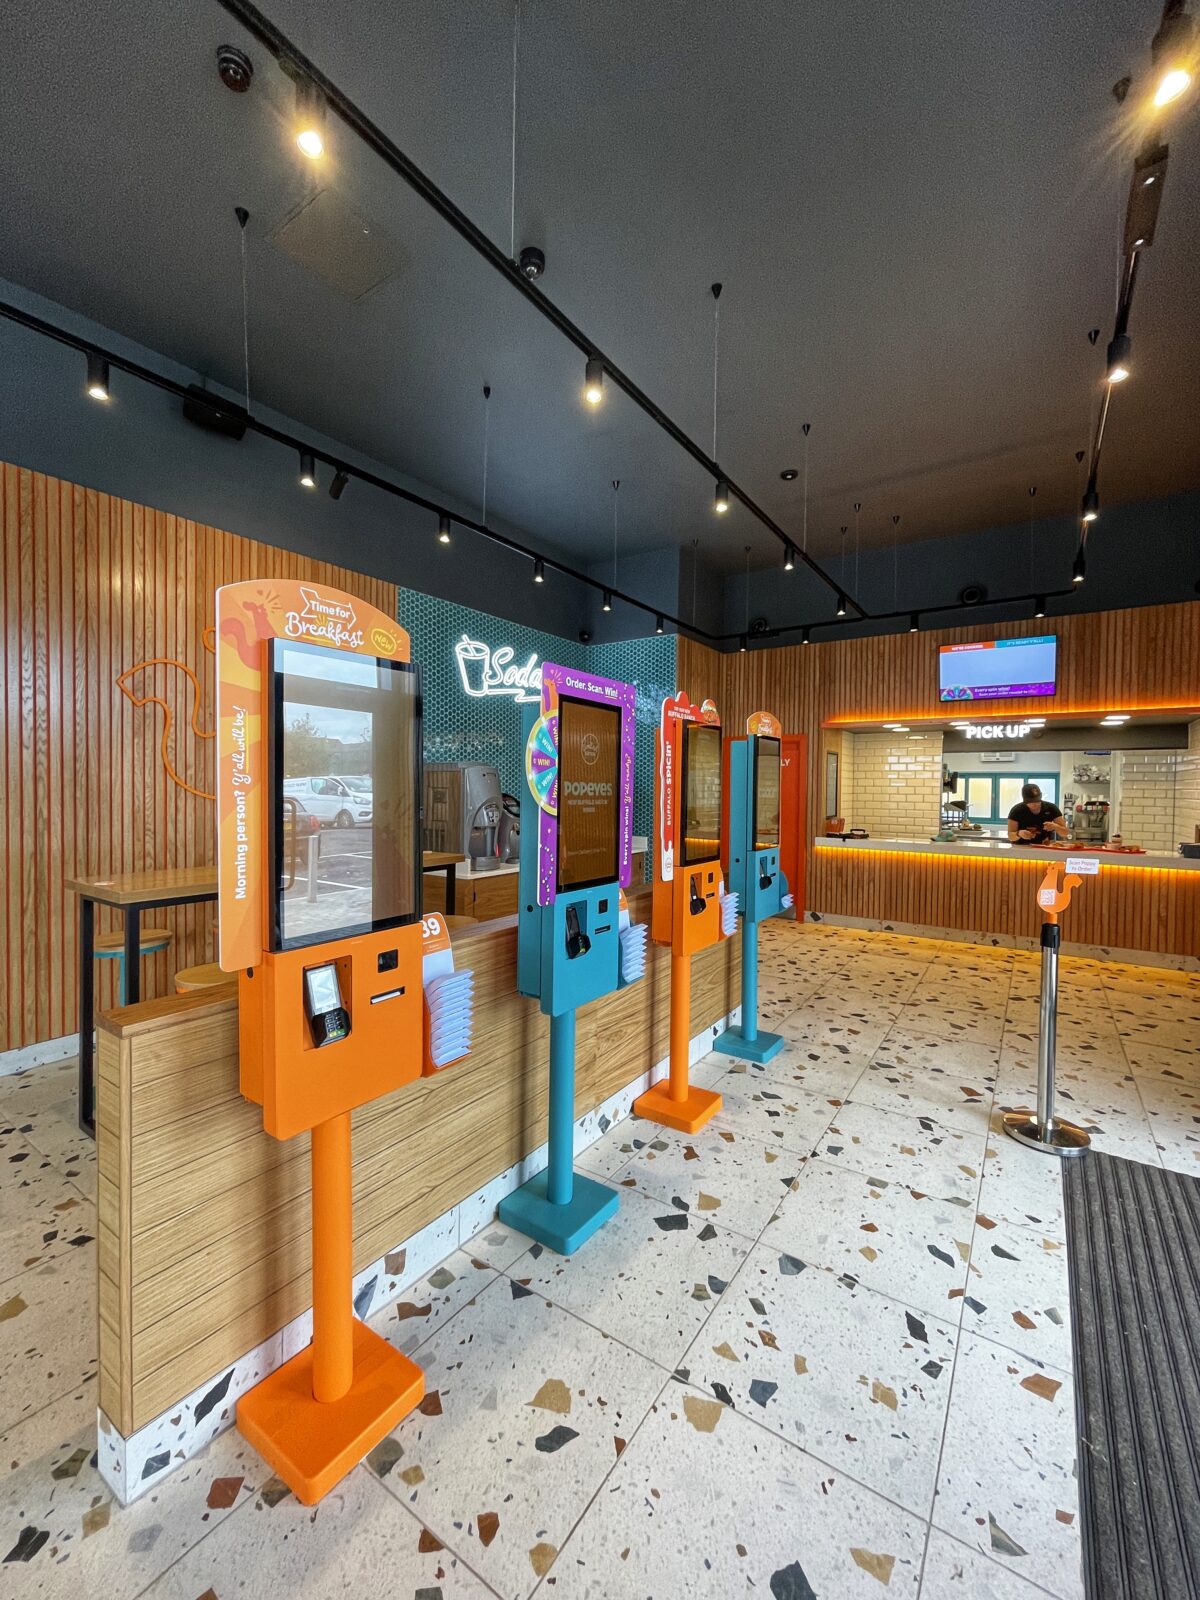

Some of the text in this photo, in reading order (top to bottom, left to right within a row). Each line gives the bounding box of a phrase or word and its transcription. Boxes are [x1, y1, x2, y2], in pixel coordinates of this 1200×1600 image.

[309, 600, 351, 618] Time for
[284, 611, 365, 648] Breakfast
[482, 646, 543, 690] Soda
[565, 676, 587, 691] Order.
[587, 682, 604, 694] Scan.
[965, 725, 1031, 739] PICK UP
[541, 737, 553, 753] WIN!
[537, 758, 551, 766] WIN!
[541, 772, 554, 787] WIN!
[231, 705, 252, 900] Morning person? Y'all will be!
